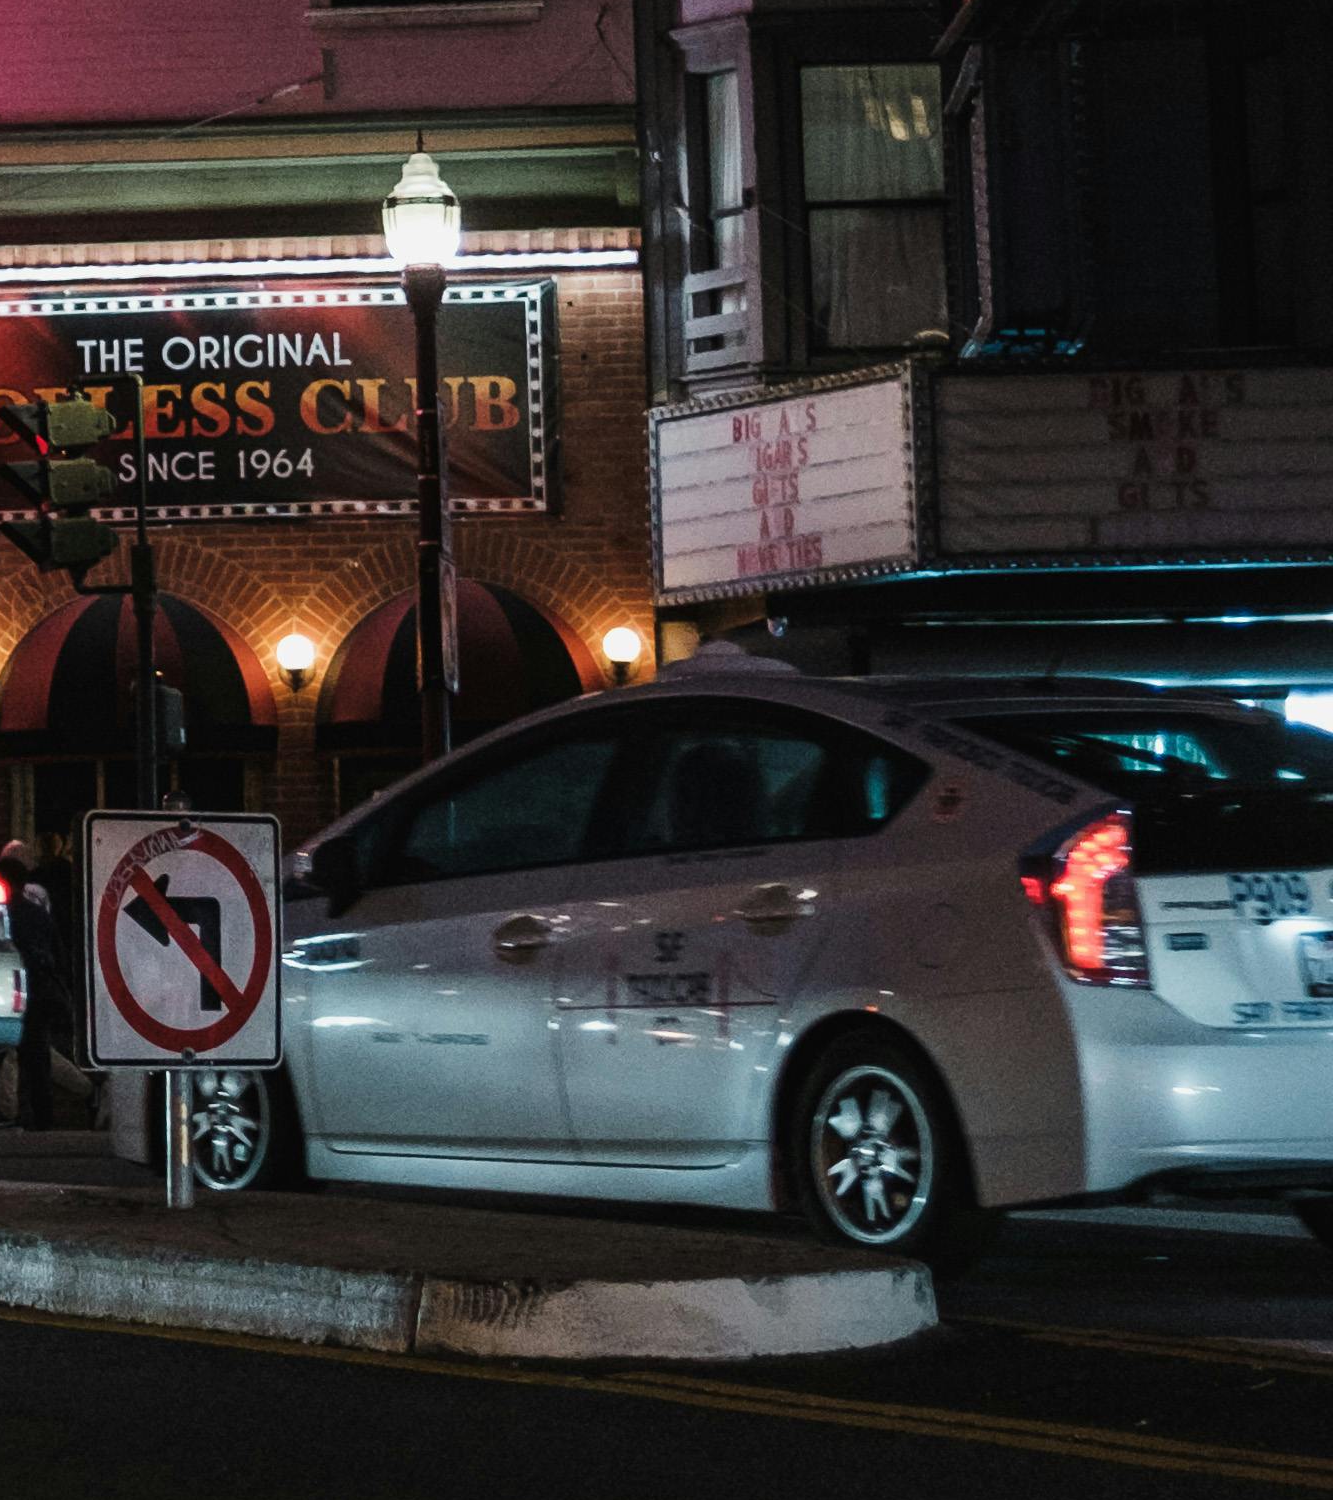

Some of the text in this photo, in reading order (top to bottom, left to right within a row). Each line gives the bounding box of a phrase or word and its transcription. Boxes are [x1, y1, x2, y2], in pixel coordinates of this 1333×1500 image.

[76, 333, 352, 373] THE ORIGINAL
[733, 411, 762, 442] BIG
[1108, 410, 1219, 441] SMKE
[119, 448, 315, 483] SNCE 1964
[752, 436, 808, 472] IGARS
[1134, 447, 1196, 475] AD
[752, 468, 800, 505] GITS
[1117, 480, 1210, 510] GITS
[759, 507, 795, 540] AD
[737, 533, 824, 575] NVETIES
